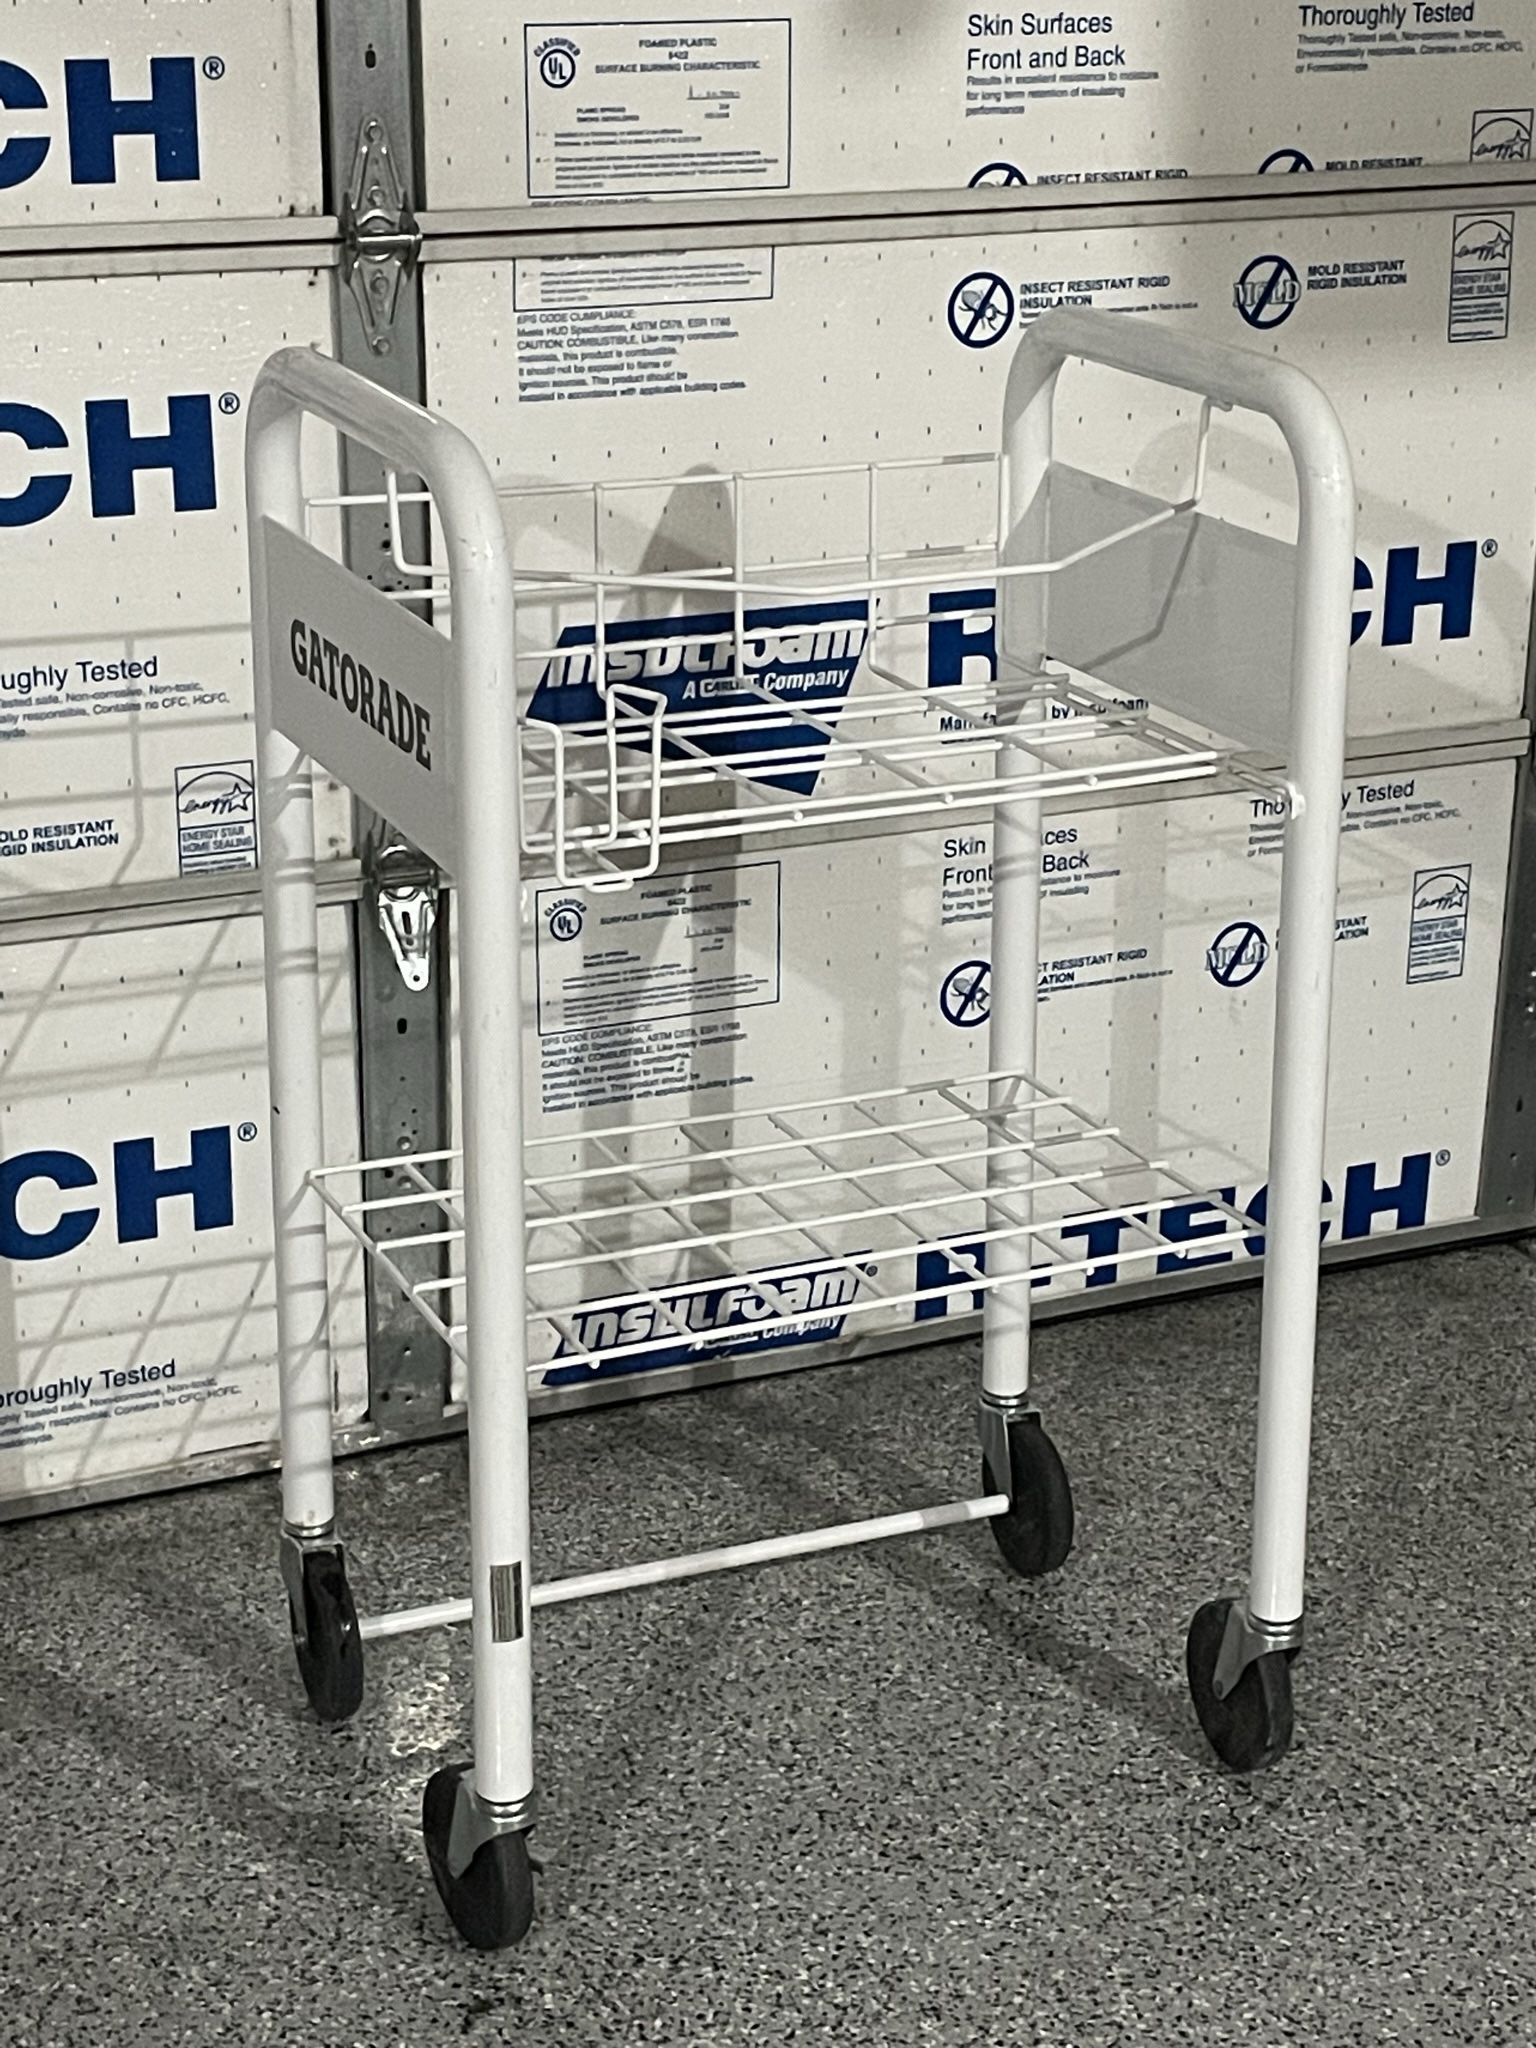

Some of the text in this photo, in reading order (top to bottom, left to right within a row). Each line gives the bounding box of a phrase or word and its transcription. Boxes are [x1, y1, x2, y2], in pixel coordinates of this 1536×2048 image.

[967, 11, 1113, 37] Skin Surfaces
[1299, 2, 1474, 30] Thoroughly Tested
[548, 57, 567, 81] UL
[967, 44, 1127, 71] Front and Back
[1307, 260, 1406, 278] MOLD RESISTANT
[1019, 275, 1171, 295] INSECT RESISTANT RIGID
[1307, 274, 1407, 290] RIGID INSULATION
[1019, 294, 1093, 309] INSULATION
[75, 655, 159, 684] Tested
[290, 618, 432, 771] GATORADE
[682, 681, 697, 700] A
[763, 667, 850, 693] Company
[93, 701, 142, 716] Contains
[1356, 779, 1416, 805] Tested
[33, 819, 114, 839] RESISTANT
[220, 825, 245, 838] STAR
[31, 833, 119, 854] INSULATION
[943, 837, 987, 859] Skin
[1042, 850, 1091, 874] Back
[942, 864, 993, 887] Front
[1051, 952, 1113, 972] RESISTANT
[1117, 947, 1148, 963] RIGID
[100, 1358, 177, 1391] Tested
